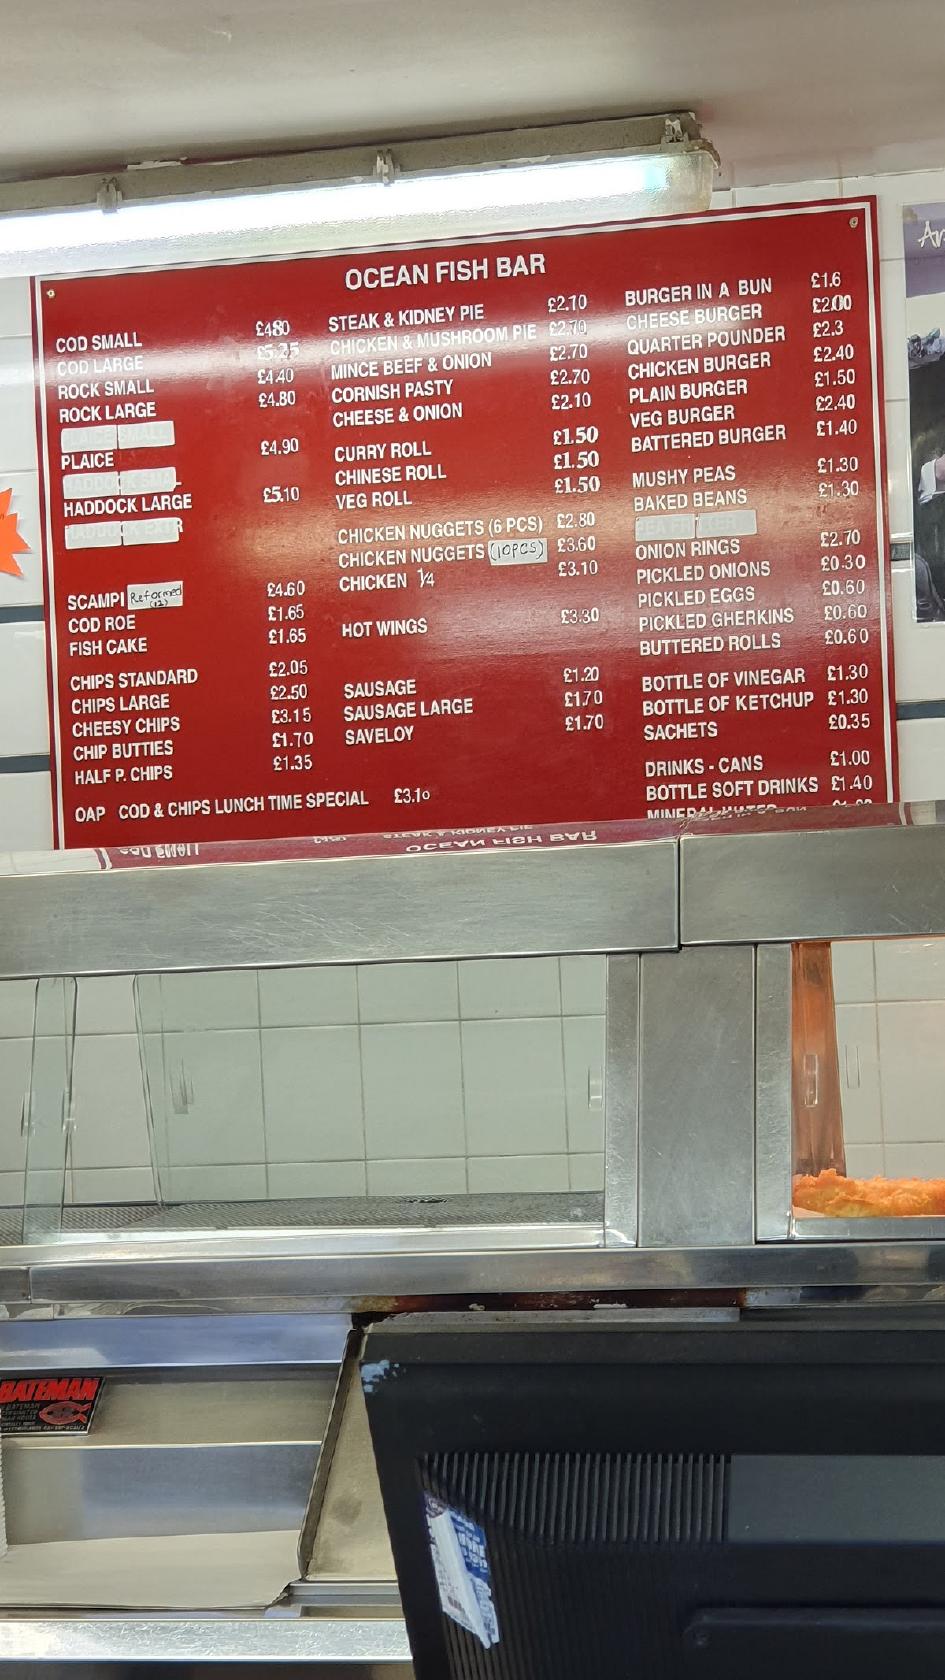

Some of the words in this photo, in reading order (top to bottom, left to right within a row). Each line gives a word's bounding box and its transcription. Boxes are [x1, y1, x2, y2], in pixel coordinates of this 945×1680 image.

[346, 264, 428, 290] OCEAN
[436, 258, 488, 282] FISH
[496, 254, 546, 278] BAR
[626, 286, 692, 306] BURGER
[697, 284, 712, 299] IN
[719, 282, 730, 298] A
[738, 278, 772, 296] BUN
[811, 272, 840, 288] £1.6
[328, 313, 380, 332] STEAK
[384, 312, 394, 328] &
[399, 306, 455, 326] KIDNEY
[460, 304, 484, 320] PIE
[627, 309, 690, 330] CHEESE
[694, 304, 762, 324] BURGER
[56, 336, 87, 352] COD
[92, 332, 142, 349] SMALL
[330, 336, 398, 355] CHICKEN
[402, 335, 412, 349] &
[417, 327, 508, 348] MUSHROOM
[513, 324, 536, 340] PIE
[628, 334, 702, 355] QUARTER
[708, 326, 785, 348] POUNDER
[813, 320, 844, 337] £2.3
[57, 360, 88, 376] COD
[93, 356, 144, 373] LARGE
[332, 361, 378, 380] MINCE
[384, 358, 422, 375] BEEF
[428, 357, 438, 371] &
[442, 352, 492, 370] ONION
[550, 344, 588, 362] £2.70
[628, 359, 698, 380] CHICKEN
[704, 352, 770, 372] BURGER
[814, 344, 854, 362] £2.40
[58, 382, 100, 400] ROCK
[105, 379, 154, 396] SMALL
[332, 384, 400, 403] CORNISH
[405, 379, 453, 398] PASTY
[550, 369, 590, 386] £2.70
[630, 385, 675, 403] PLAIN
[680, 379, 748, 399] BURGER
[814, 369, 854, 387] £1.50
[60, 406, 102, 422] ROCK
[106, 402, 156, 420] LARGE
[258, 391, 296, 408] £4.80
[332, 408, 394, 428] CHEESE
[399, 407, 409, 422] &
[414, 402, 462, 421] ONION
[552, 392, 591, 410] £2.10
[630, 410, 662, 428] VEG
[668, 405, 734, 424] BURGER
[334, 444, 386, 462] CURRY
[390, 441, 432, 459] ROLL
[553, 426, 598, 445] £1.50
[632, 432, 714, 452] BATTERED
[718, 425, 786, 445] BURGER
[816, 419, 857, 436] £1.40
[61, 452, 114, 470] PLAICE
[260, 438, 298, 456] £4.90
[335, 466, 400, 486] CHINESE
[406, 464, 446, 481] ROLL
[554, 450, 599, 470] £1.50
[632, 470, 688, 488] MUSHY
[694, 466, 735, 484] PEAS
[818, 457, 858, 474] £1.30
[64, 499, 138, 517] HADDOCK
[142, 494, 192, 512] LARGE
[336, 493, 367, 510] VEG
[371, 490, 412, 508] ROLL
[554, 476, 600, 494] £1.50
[634, 494, 688, 512] BAKED
[694, 490, 747, 507] BEANS
[338, 526, 406, 544] CHICKEN
[410, 520, 484, 539] NUGGETS
[488, 518, 500, 536] (6
[506, 516, 543, 534] PCS)
[557, 512, 595, 529] £2.80
[338, 550, 406, 568] CHICKEN
[411, 544, 484, 562] NUGGETS
[636, 542, 686, 560] ONION
[691, 538, 740, 556] RINGS
[820, 530, 860, 548] £2.70
[340, 574, 406, 592] CHICKEN
[558, 560, 598, 576] £3.10
[637, 566, 704, 584] PICKLED
[710, 560, 770, 580] ONIONS
[68, 592, 124, 610] SCAMPI
[267, 580, 305, 597] £4.60
[130, 585, 182, 604] Reformed
[638, 590, 705, 608] PICKLED
[710, 586, 755, 602] EGGS
[822, 580, 864, 596] £0.60
[68, 617, 100, 633] COD
[105, 615, 135, 631] ROE
[342, 622, 372, 638] HOT
[376, 618, 428, 636] WINGS
[639, 614, 706, 632] PICKLED
[712, 608, 794, 628] GHERKINS
[824, 604, 866, 621] £0.60
[70, 640, 102, 656] FISH
[106, 638, 147, 654] CAKE
[268, 628, 306, 644] £1.65
[640, 636, 724, 656] BUTTERED
[728, 633, 780, 651] ROLLS
[824, 628, 868, 645] £0.60
[70, 674, 114, 691] CHIPS
[118, 668, 198, 688] STANDARD
[269, 660, 308, 677] £2.05
[344, 680, 416, 698] SAUSAGE
[642, 674, 702, 692] BOTTLE
[708, 672, 728, 688] OF
[733, 668, 805, 686] VINEGAR
[827, 664, 868, 681] £1.30
[72, 697, 115, 714] CHIPS
[120, 694, 170, 711] LARGE
[270, 684, 307, 700] £2.50
[344, 703, 416, 722] SAUSAGE
[420, 698, 473, 716] LARGE
[642, 697, 704, 716] BOTTLE
[708, 696, 729, 712] OF
[736, 691, 814, 712] KETCHUP
[828, 688, 868, 706] £1.30
[72, 720, 131, 737] CHEESY
[135, 716, 180, 733] CHIPS
[271, 708, 311, 724] £3.15
[346, 726, 414, 745] SAVELOY
[565, 715, 604, 732] £1.70
[644, 721, 718, 740] SACHETS
[828, 713, 870, 730] £0.35
[73, 744, 107, 761] CHIP
[112, 740, 173, 758] BUTTIES
[272, 732, 313, 748] £1.70
[75, 768, 110, 785] HALF
[116, 768, 126, 782] P.
[130, 766, 172, 782] CHIPS
[273, 754, 312, 771] £1.35
[645, 758, 704, 777] DRINKS
[718, 755, 763, 774] CANS
[830, 750, 870, 767] £1.00
[646, 783, 706, 801] BOTTLE
[712, 780, 754, 798] SOFT
[758, 776, 818, 796] DRINKS
[75, 806, 106, 823] OAP
[118, 804, 150, 820] COD
[154, 802, 164, 818] &
[168, 800, 210, 817] CHIPS
[215, 796, 264, 814] LUNCH
[268, 794, 302, 811] TIME
[306, 790, 368, 809] SPECIAL
[0, 1379, 99, 1405] BATEMAN
